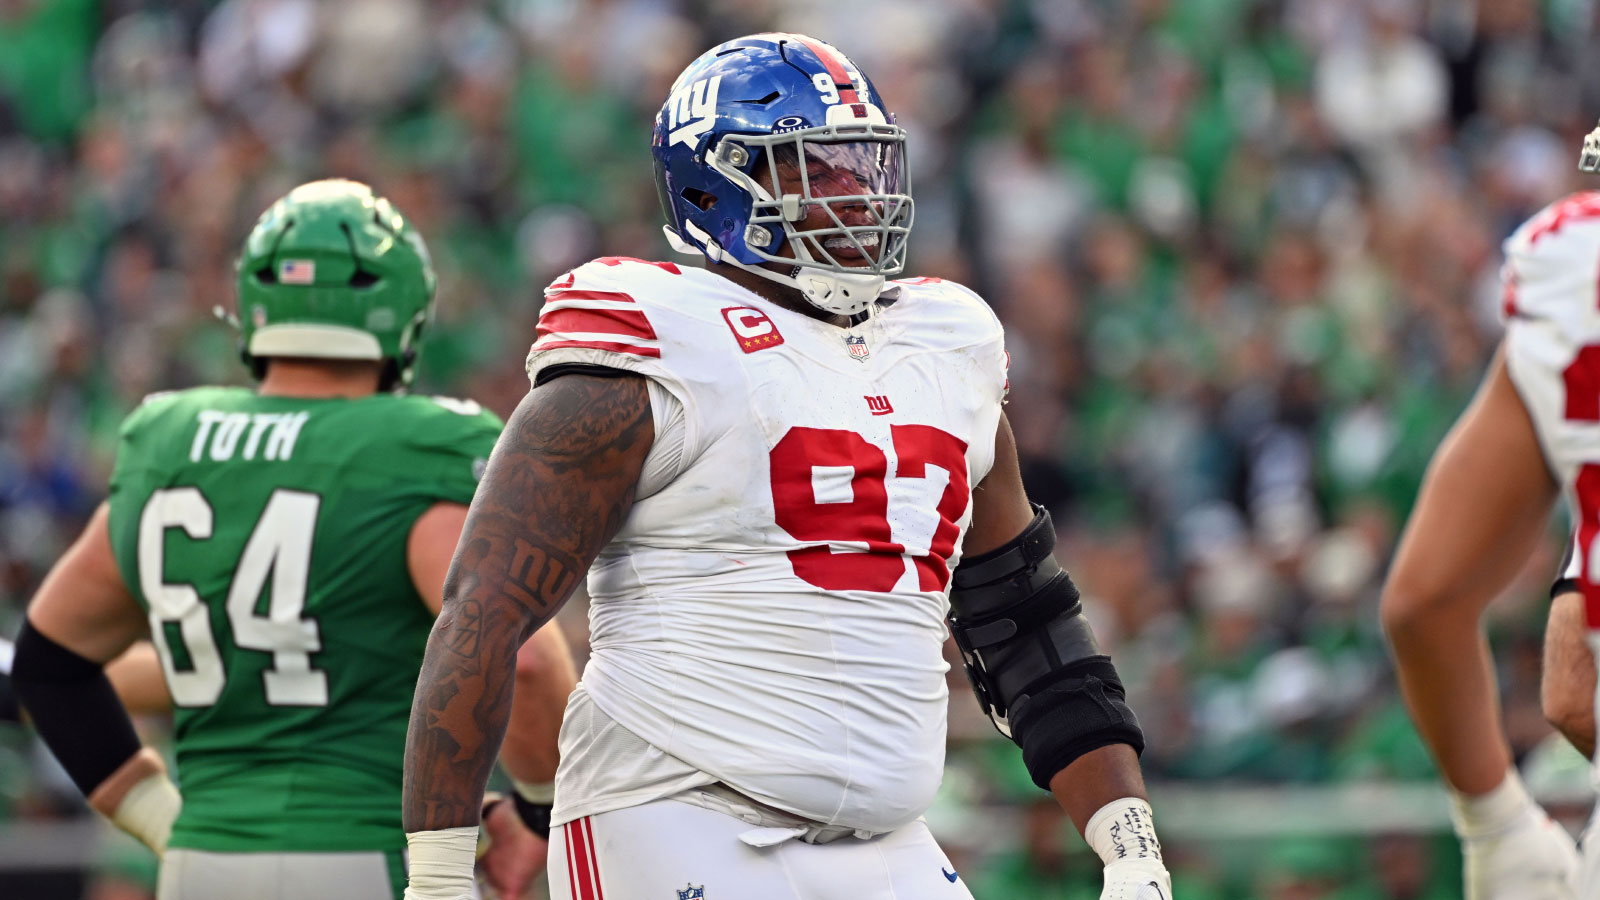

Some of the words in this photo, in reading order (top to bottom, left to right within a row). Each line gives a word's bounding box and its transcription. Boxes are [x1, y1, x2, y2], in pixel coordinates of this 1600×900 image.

[772, 124, 810, 135] OAKLEY
[727, 308, 773, 339] C
[849, 344, 868, 356] NFL
[190, 410, 309, 462] TOTH
[769, 423, 970, 593] 97
[137, 487, 328, 708] 64
